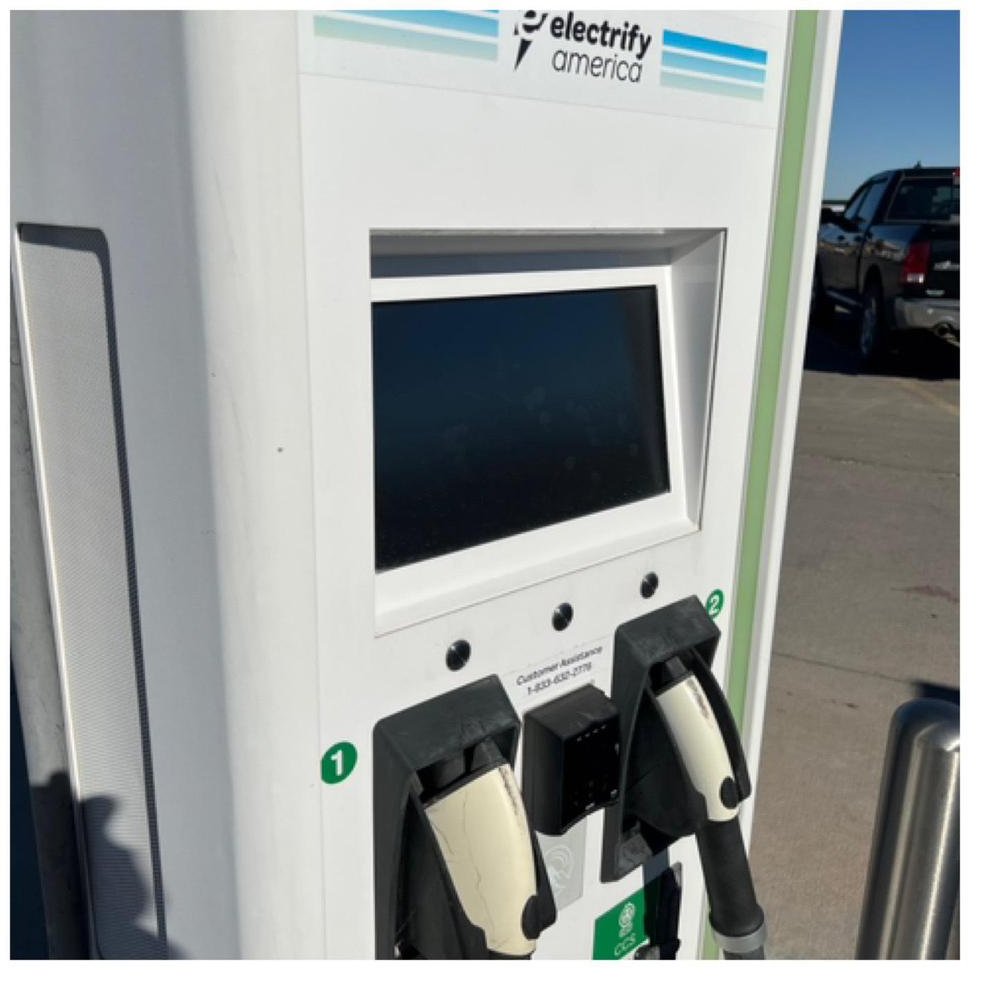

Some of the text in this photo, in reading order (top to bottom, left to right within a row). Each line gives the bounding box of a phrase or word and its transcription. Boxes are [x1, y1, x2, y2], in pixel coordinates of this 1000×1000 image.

[550, 10, 653, 60] electrify
[551, 48, 643, 83] america
[708, 594, 721, 616] 2
[516, 662, 559, 686] Customer
[331, 749, 344, 777] 1
